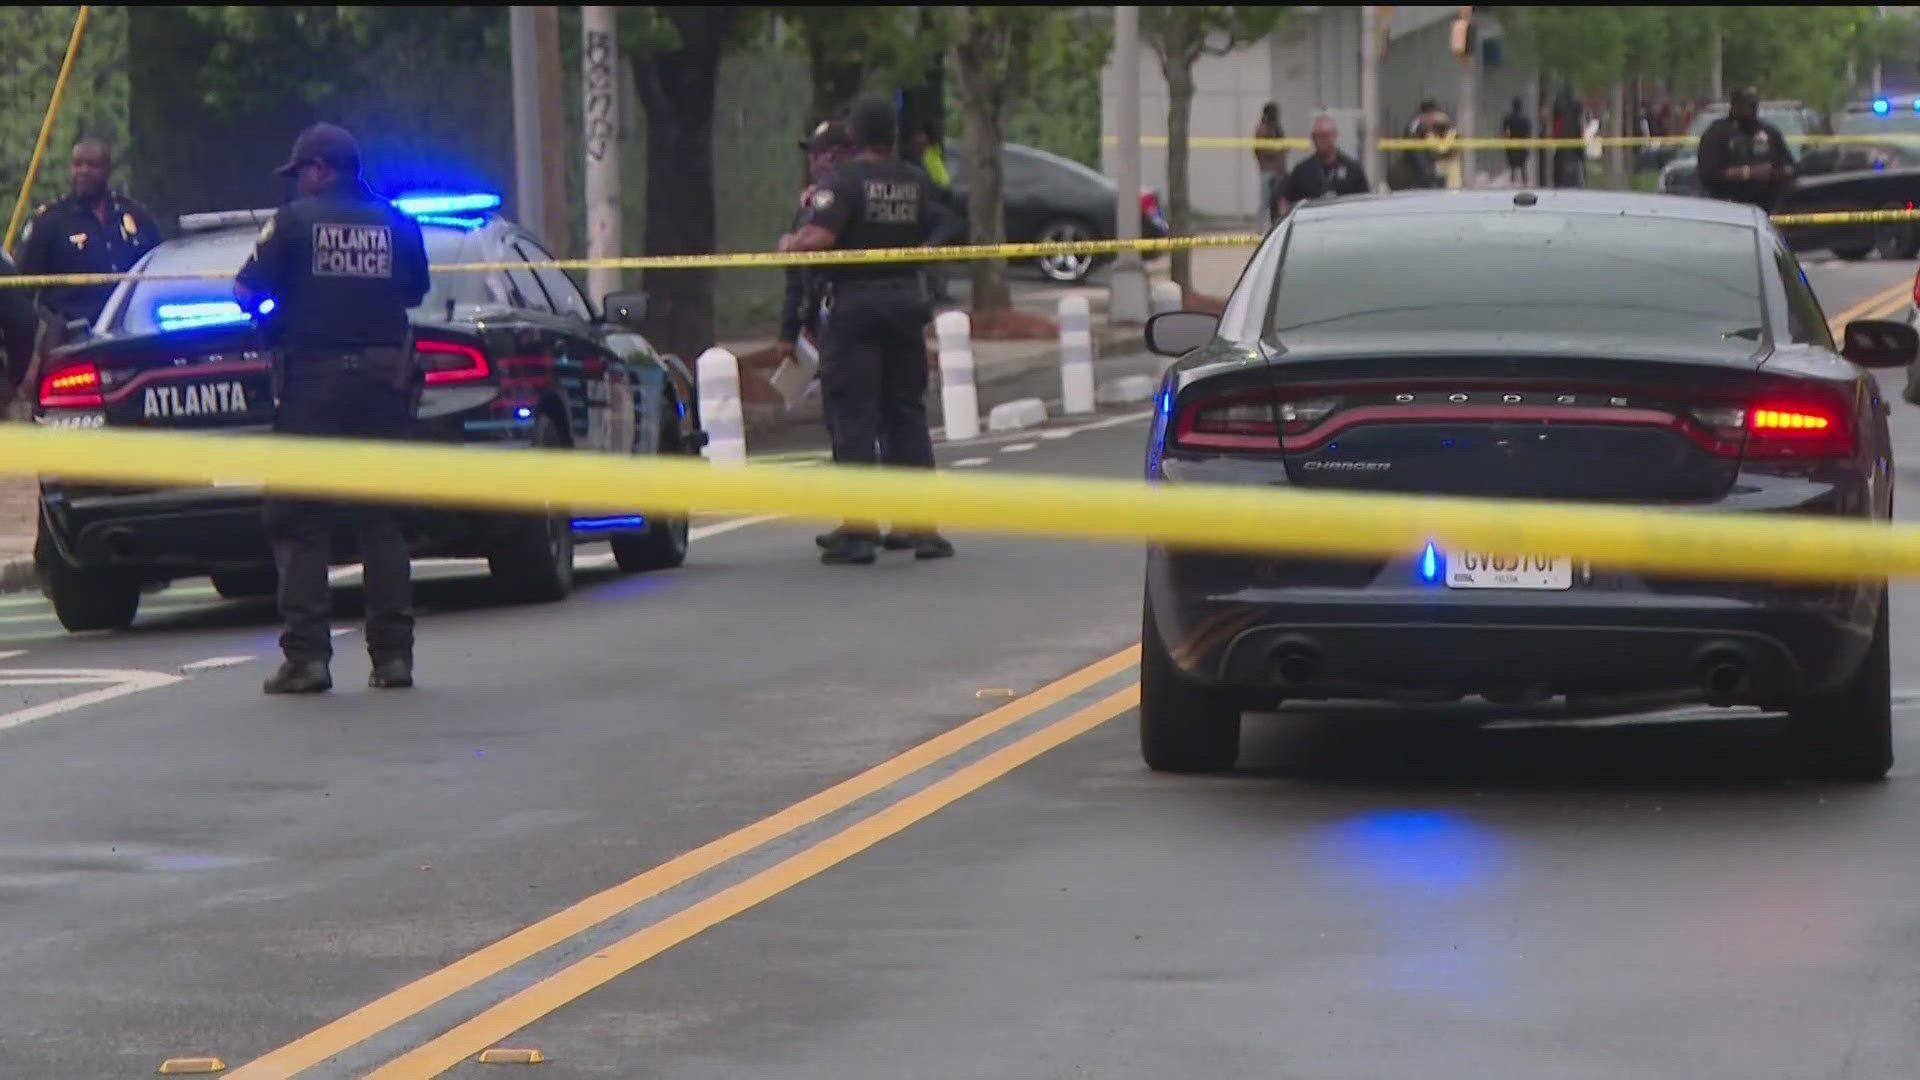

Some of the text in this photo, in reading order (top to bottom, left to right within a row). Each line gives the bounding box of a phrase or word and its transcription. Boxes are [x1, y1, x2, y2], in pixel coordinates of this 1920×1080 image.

[318, 227, 388, 251] ATLANTA
[317, 252, 389, 274] POLICE
[143, 381, 247, 417] ATLANTA
[1396, 393, 1628, 406] DODGE
[1303, 461, 1391, 470] CHARGER
